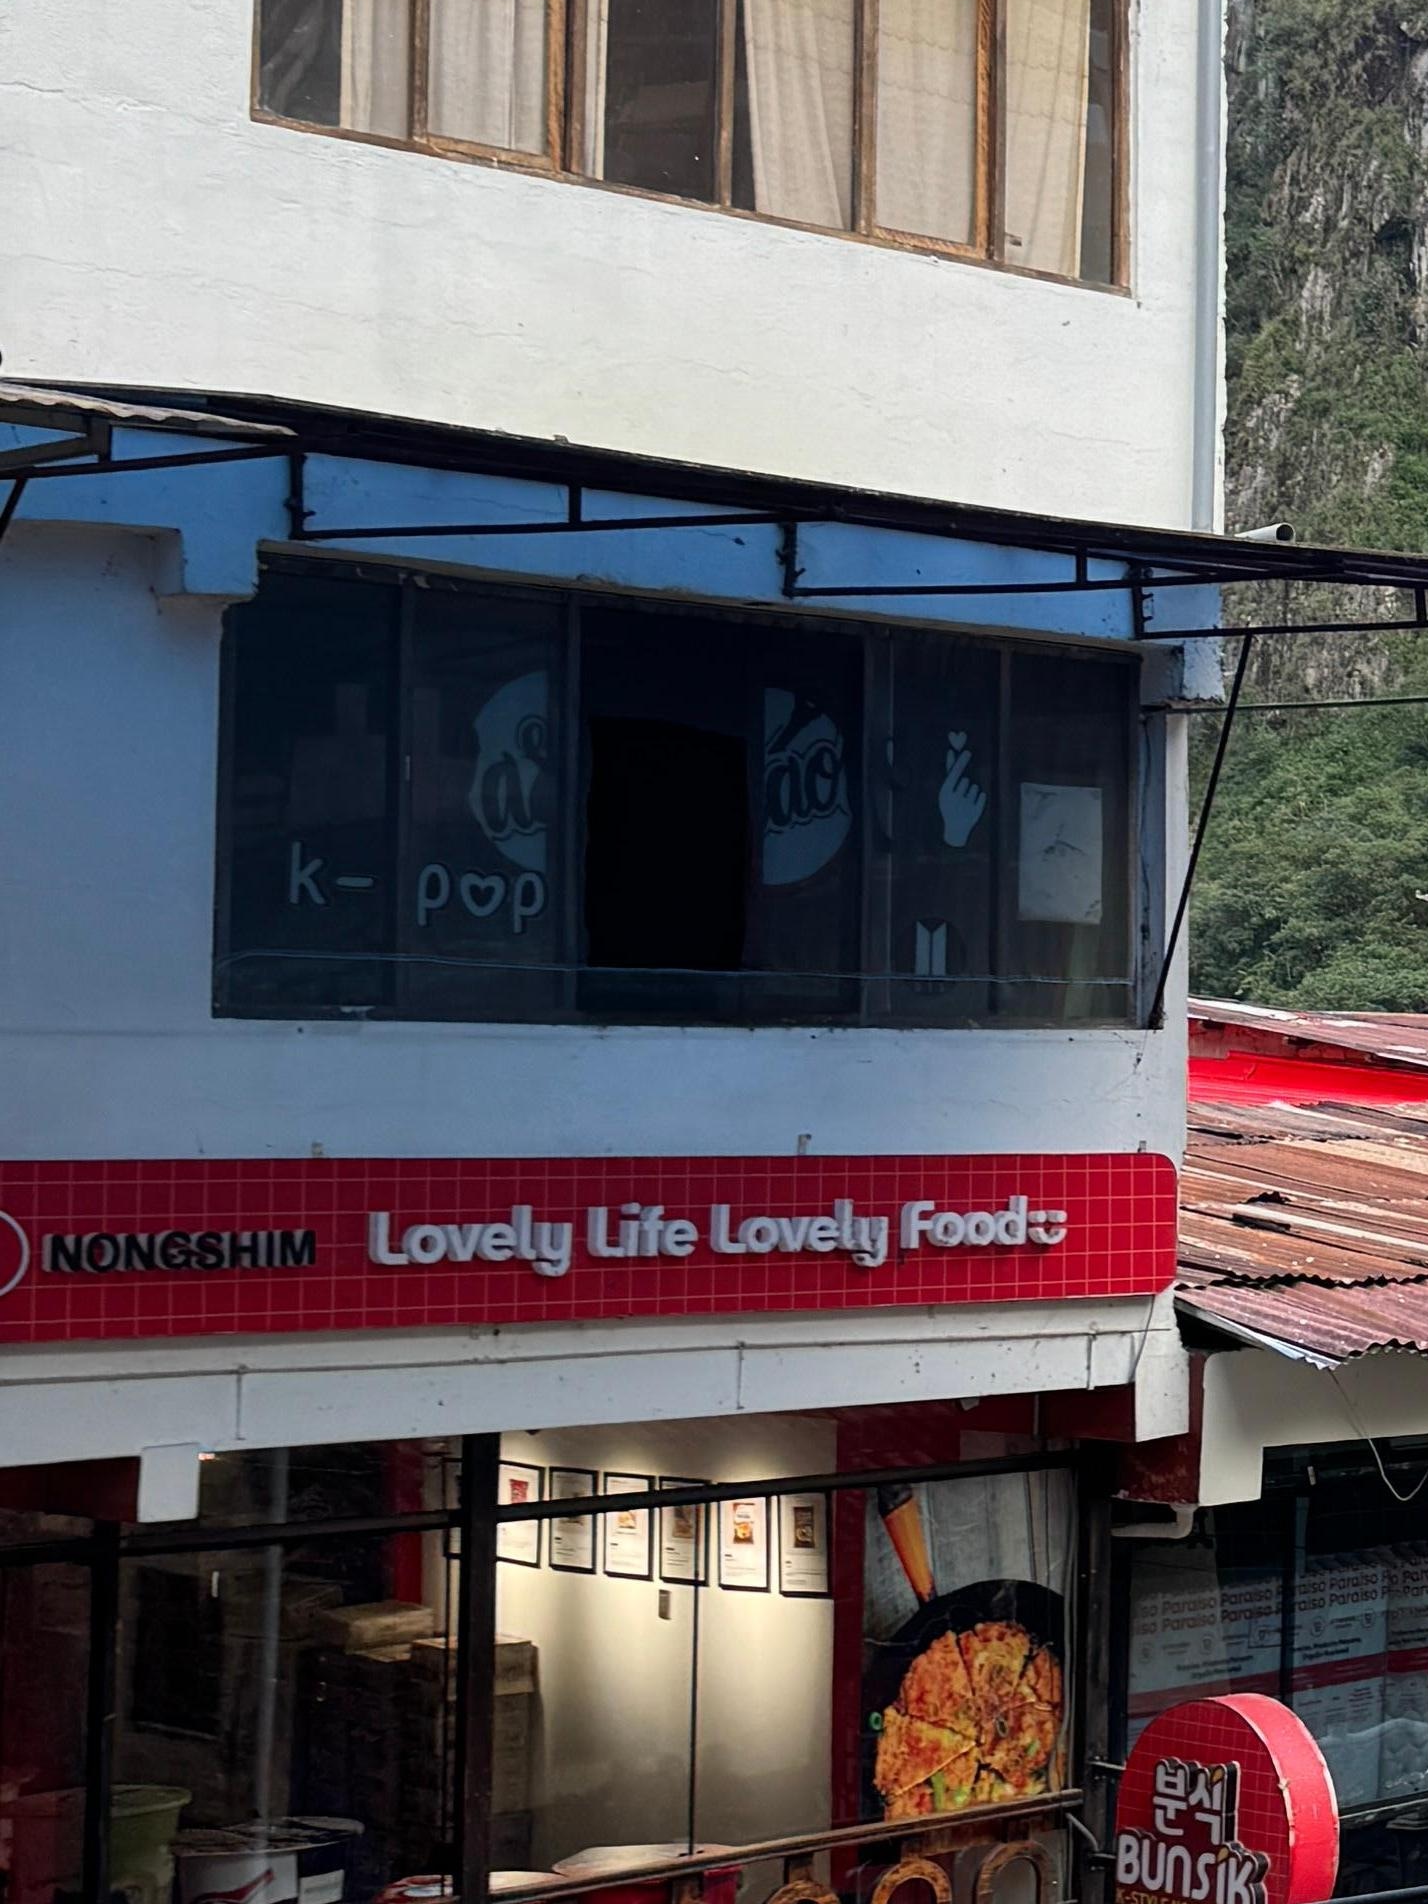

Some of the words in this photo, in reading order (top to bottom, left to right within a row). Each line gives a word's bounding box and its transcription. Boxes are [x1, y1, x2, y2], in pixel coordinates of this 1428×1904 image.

[43, 1229, 317, 1273] NONGSHIM
[367, 1204, 573, 1277] Lovely
[587, 1201, 699, 1258] Life
[710, 1198, 889, 1268] Lovely
[1163, 1597, 1217, 1615] Paraiso
[1221, 1587, 1272, 1607] Paraiso
[1329, 1573, 1379, 1590] Paraiso
[1163, 1614, 1217, 1632] Paraiso
[1329, 1590, 1379, 1607] Paraiso
[1153, 1764, 1225, 1846] 분식
